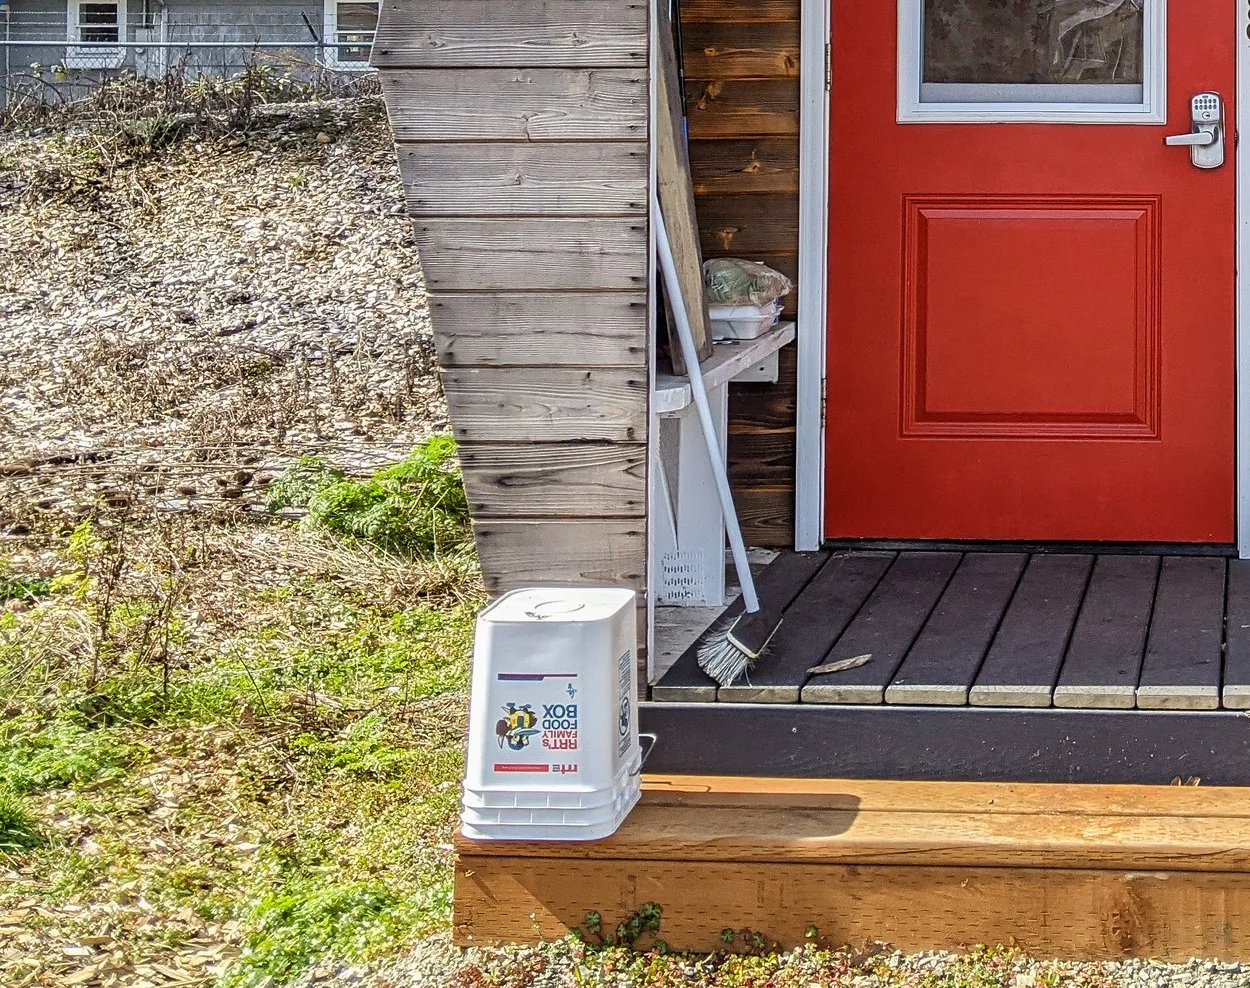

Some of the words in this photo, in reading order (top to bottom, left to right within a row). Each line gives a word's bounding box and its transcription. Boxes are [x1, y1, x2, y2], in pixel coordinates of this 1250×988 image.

[542, 704, 578, 718] BOX
[542, 719, 578, 729] FOOD
[542, 730, 578, 738] FAMILY
[542, 739, 578, 750] RRT's
